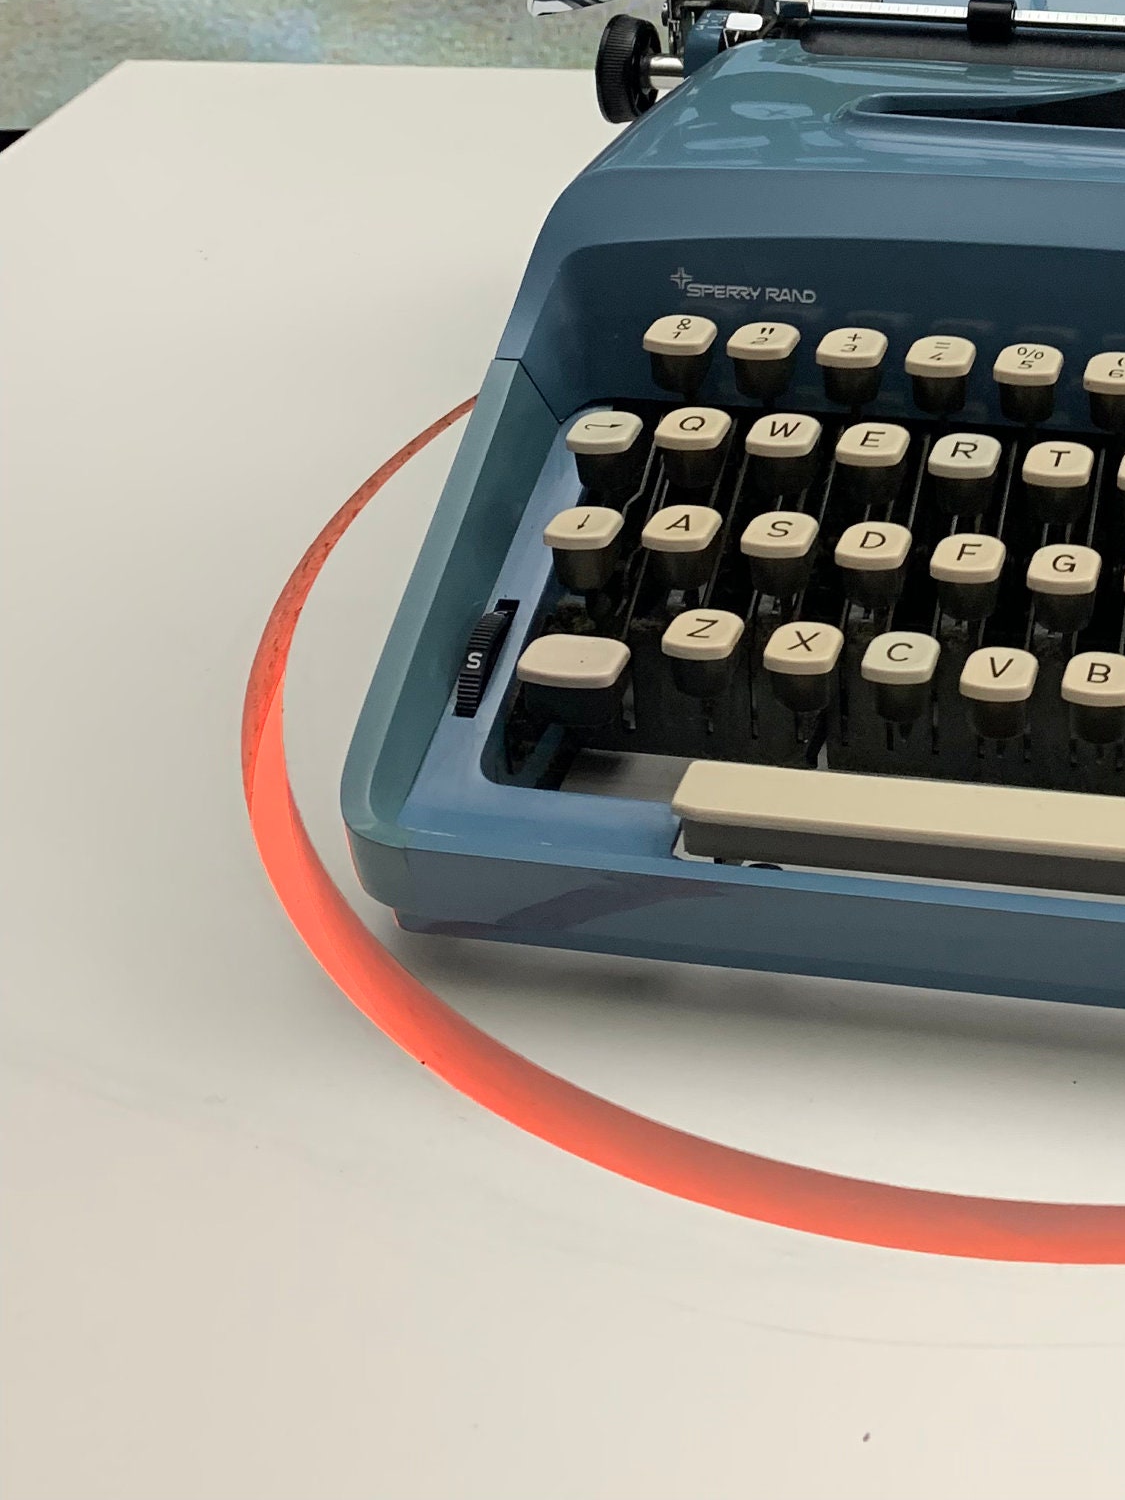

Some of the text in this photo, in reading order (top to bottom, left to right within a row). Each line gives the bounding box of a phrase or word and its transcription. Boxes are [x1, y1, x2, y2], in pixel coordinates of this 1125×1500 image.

[686, 283, 817, 304] SPERRY RAND
[679, 415, 706, 432] Q
[769, 420, 801, 438] W
[859, 430, 886, 447] E
[950, 440, 978, 459] R
[1049, 449, 1071, 468] T
[664, 514, 690, 532] A
[767, 520, 793, 538] S
[859, 530, 887, 549] D
[956, 543, 983, 561] F
[1052, 554, 1077, 573] G
[466, 651, 483, 669] S
[686, 618, 719, 639] Z
[788, 630, 820, 652] X
[886, 642, 914, 662] C
[989, 656, 1014, 679] V
[1086, 662, 1112, 684] B
